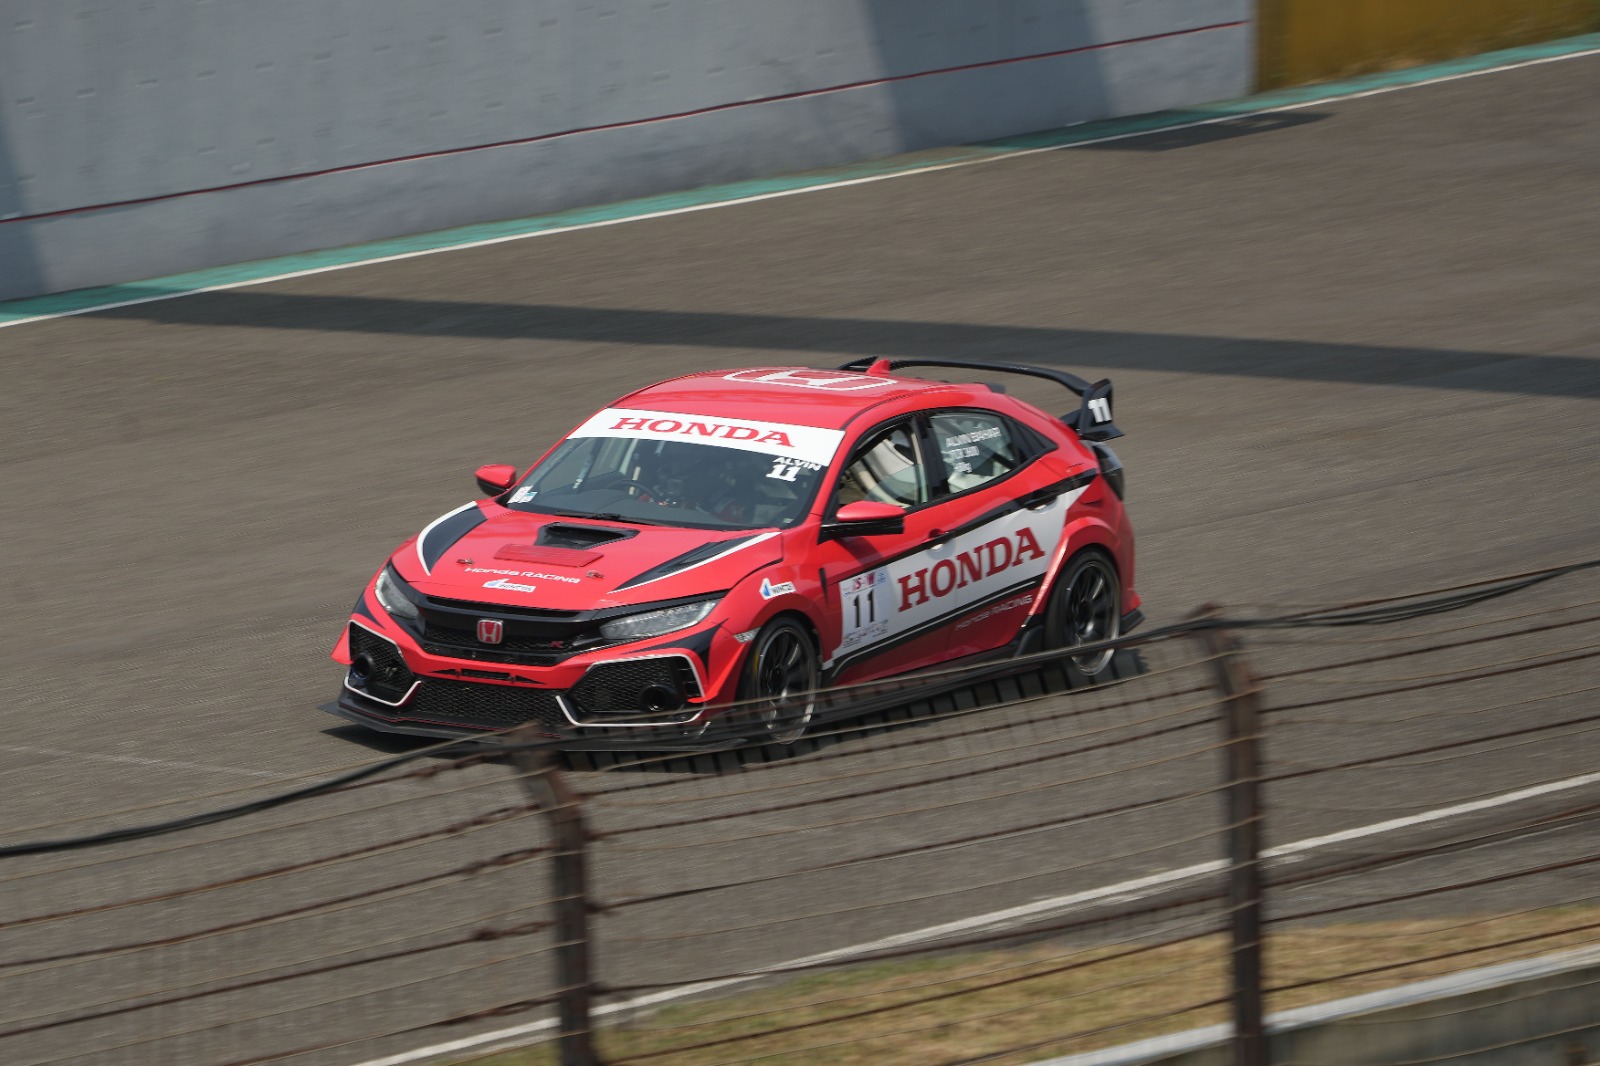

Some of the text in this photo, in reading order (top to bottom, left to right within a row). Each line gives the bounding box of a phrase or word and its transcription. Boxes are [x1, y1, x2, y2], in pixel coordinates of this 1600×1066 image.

[1087, 397, 1113, 423] 11
[608, 417, 796, 448] HONDA
[765, 464, 802, 482] 11
[772, 456, 822, 471] ALVIN
[520, 571, 581, 584] RACING
[897, 527, 1046, 613] HONDA
[853, 588, 876, 629] 11
